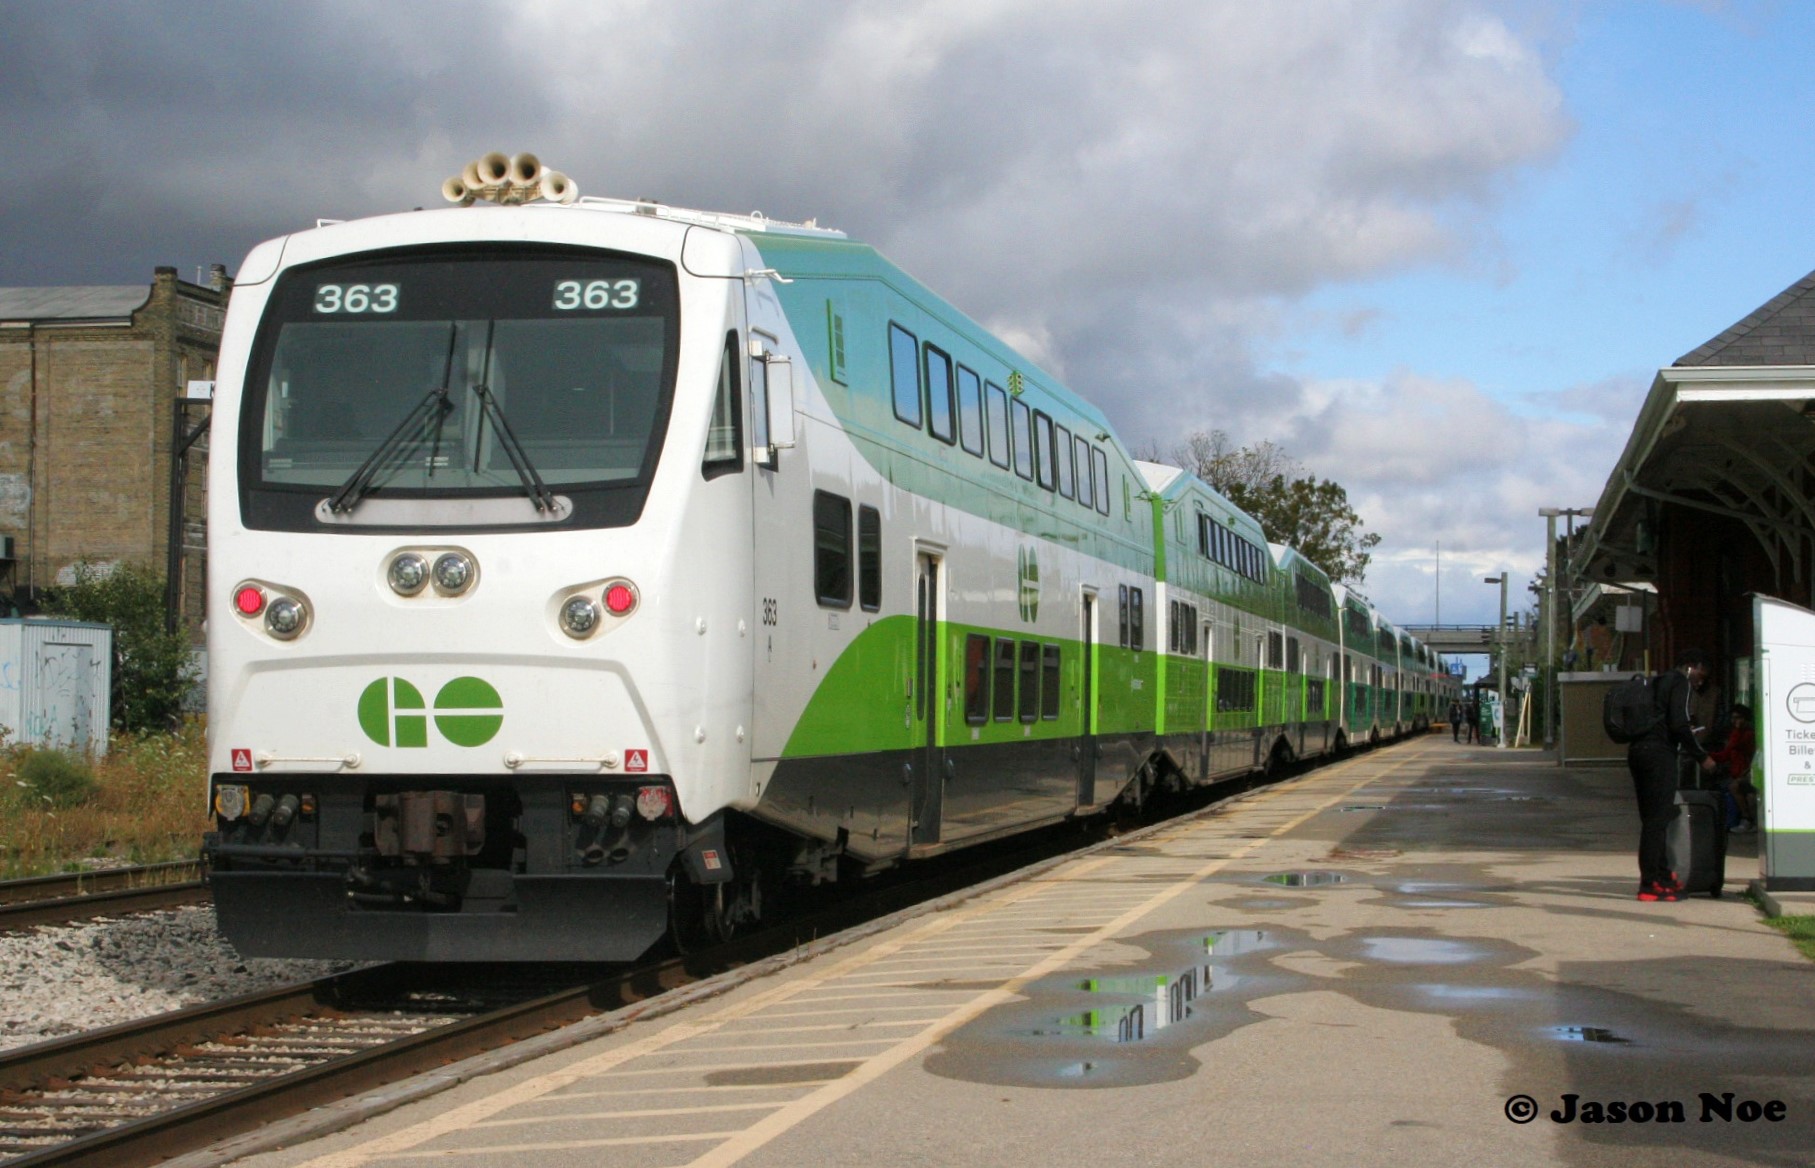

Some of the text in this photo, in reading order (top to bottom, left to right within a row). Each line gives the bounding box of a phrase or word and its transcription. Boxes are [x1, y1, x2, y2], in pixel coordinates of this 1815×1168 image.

[316, 285, 398, 313] 363
[555, 280, 637, 309] 363
[763, 597, 777, 626] 363
[357, 676, 504, 748] GO
[1789, 745, 1815, 755] Bille
